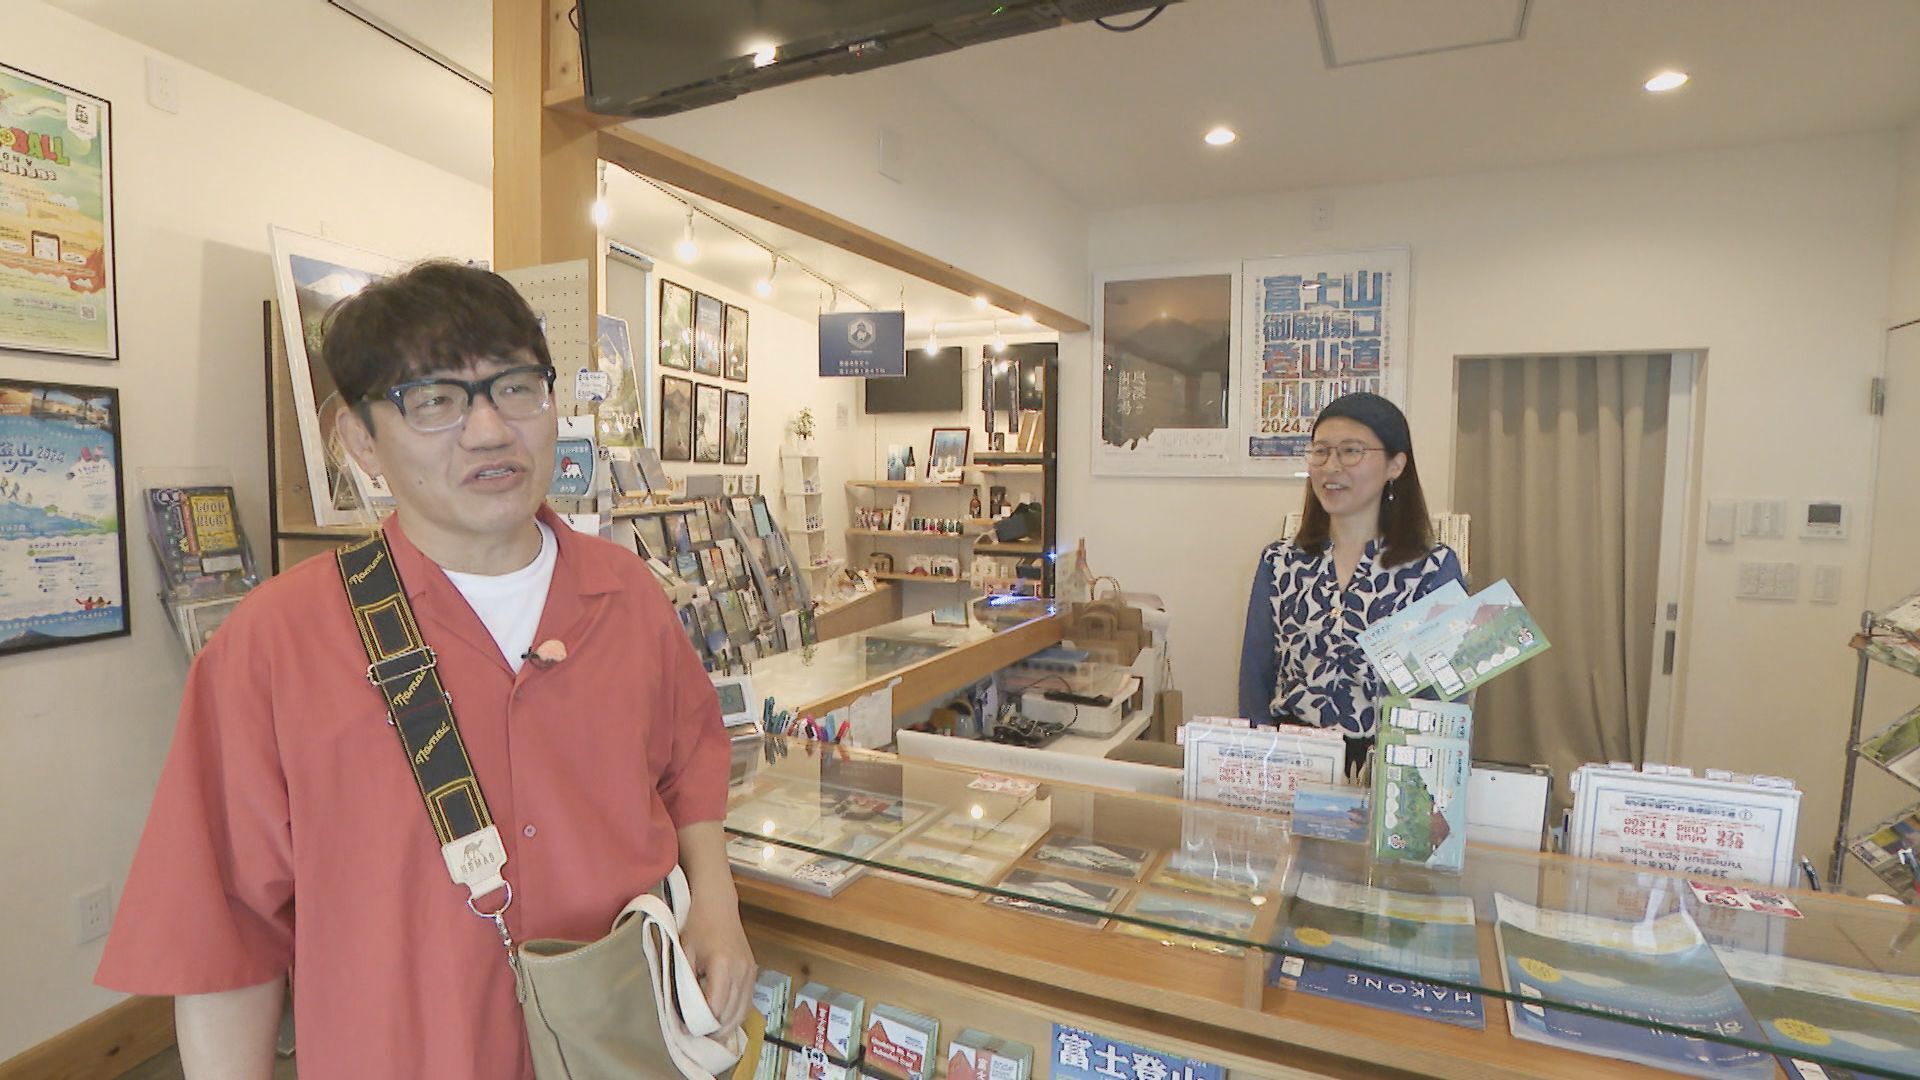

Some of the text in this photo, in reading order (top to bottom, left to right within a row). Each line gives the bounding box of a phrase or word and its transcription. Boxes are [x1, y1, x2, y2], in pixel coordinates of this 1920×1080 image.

[1264, 270, 1382, 312] 富士山
[1263, 309, 1381, 341] 御殿場口
[1262, 339, 1381, 379] 登山道
[1675, 832, 1708, 844] Adult
[1676, 823, 1707, 835] Child
[1619, 845, 1653, 859] Ticket
[1658, 851, 1681, 862] Spa
[1346, 974, 1472, 1003] HAKONE
